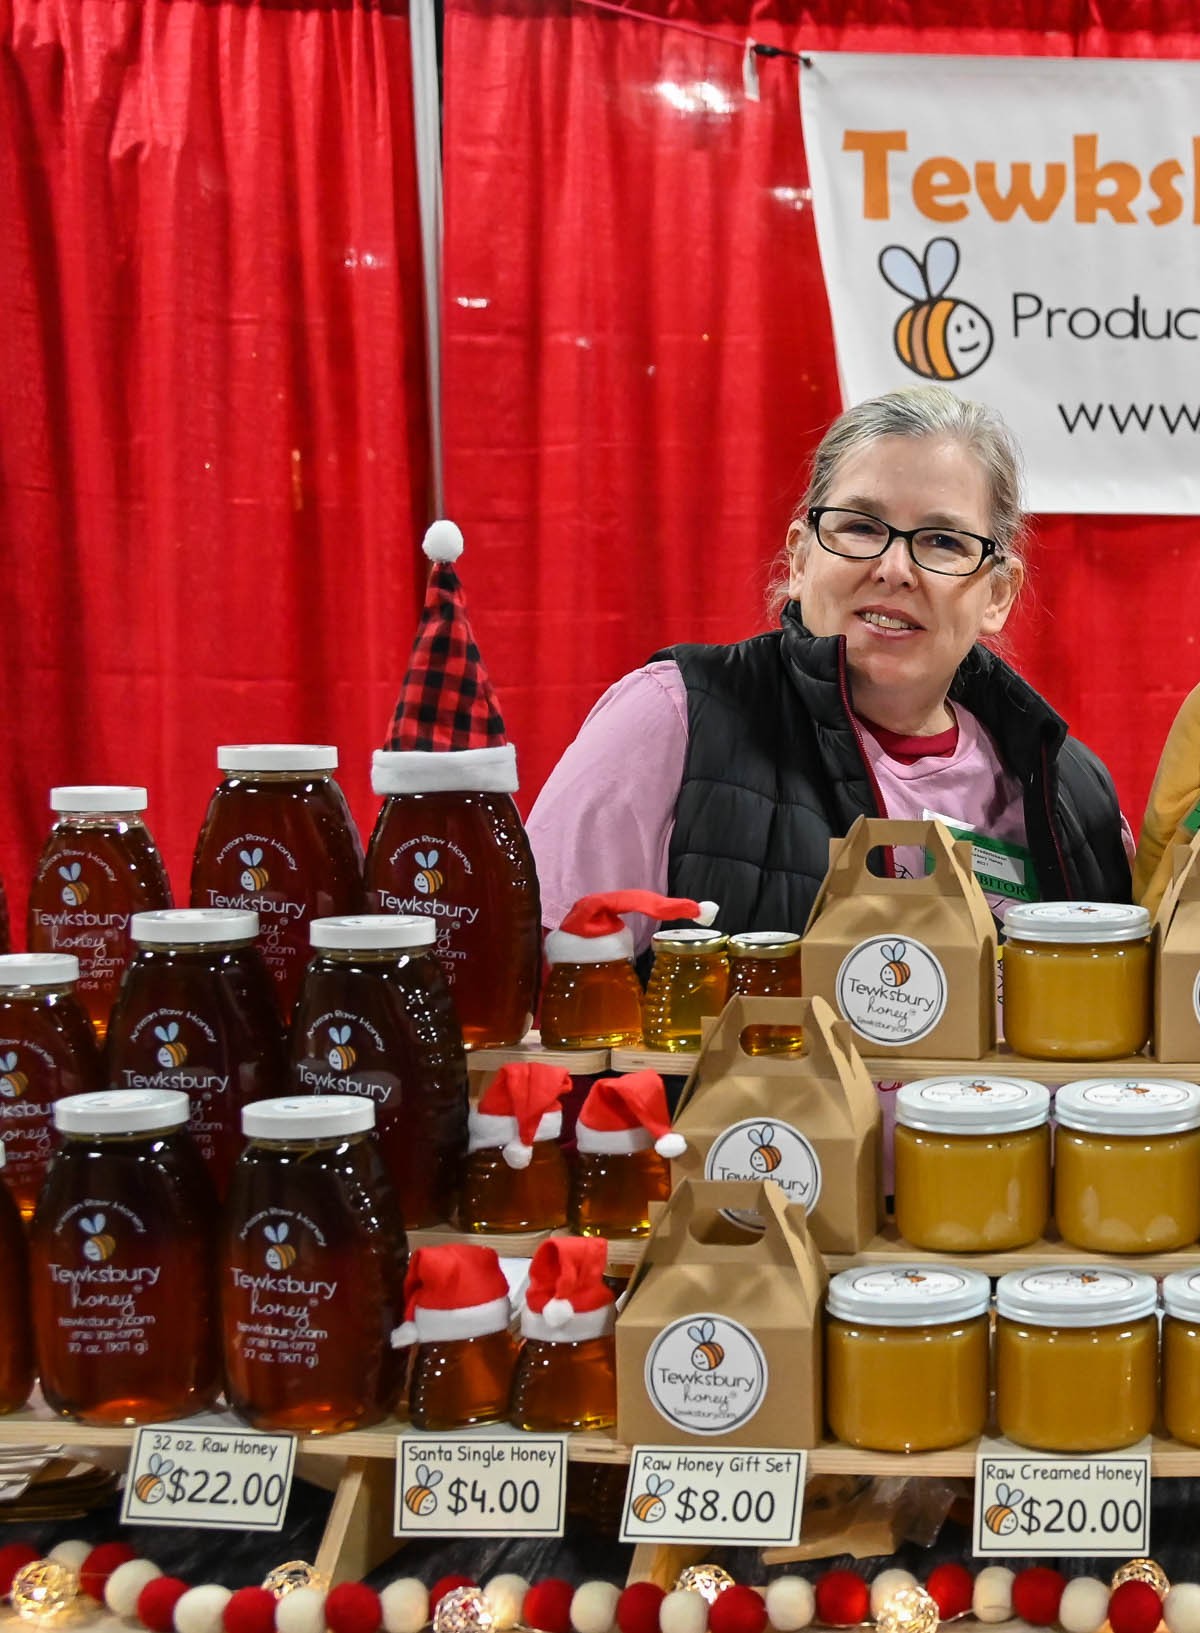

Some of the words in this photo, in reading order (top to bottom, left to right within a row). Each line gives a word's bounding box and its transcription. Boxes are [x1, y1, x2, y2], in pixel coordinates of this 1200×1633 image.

[32, 908, 129, 929] Tewksbury
[206, 889, 306, 919] Tewksbury
[377, 889, 480, 924] Tewksbury
[848, 977, 935, 1012] Tewksbury
[122, 1069, 229, 1093] Tewksbury
[297, 1063, 392, 1103] Tewksbury
[48, 1263, 161, 1284] Tewksbury
[230, 1267, 338, 1300] Tewksbury
[659, 1367, 755, 1393] Tewksbury
[152, 1434, 172, 1450] 32
[175, 1439, 196, 1451] oz.
[202, 1437, 230, 1454] Raw
[233, 1440, 278, 1462] Honey
[408, 1444, 453, 1462] Santa
[457, 1444, 505, 1468] Single
[510, 1446, 557, 1468] Honey
[642, 1455, 672, 1471] Raw
[676, 1457, 724, 1478] Honey
[729, 1456, 761, 1473] Gift
[765, 1457, 793, 1473] Set
[985, 1463, 1015, 1480] Raw
[1020, 1463, 1091, 1480] Creamed
[1095, 1465, 1143, 1487] Honey
[166, 1465, 286, 1507] $22.00
[447, 1477, 540, 1516] $4.00
[674, 1486, 776, 1524] $8.00
[1020, 1496, 1143, 1536] $20.00
